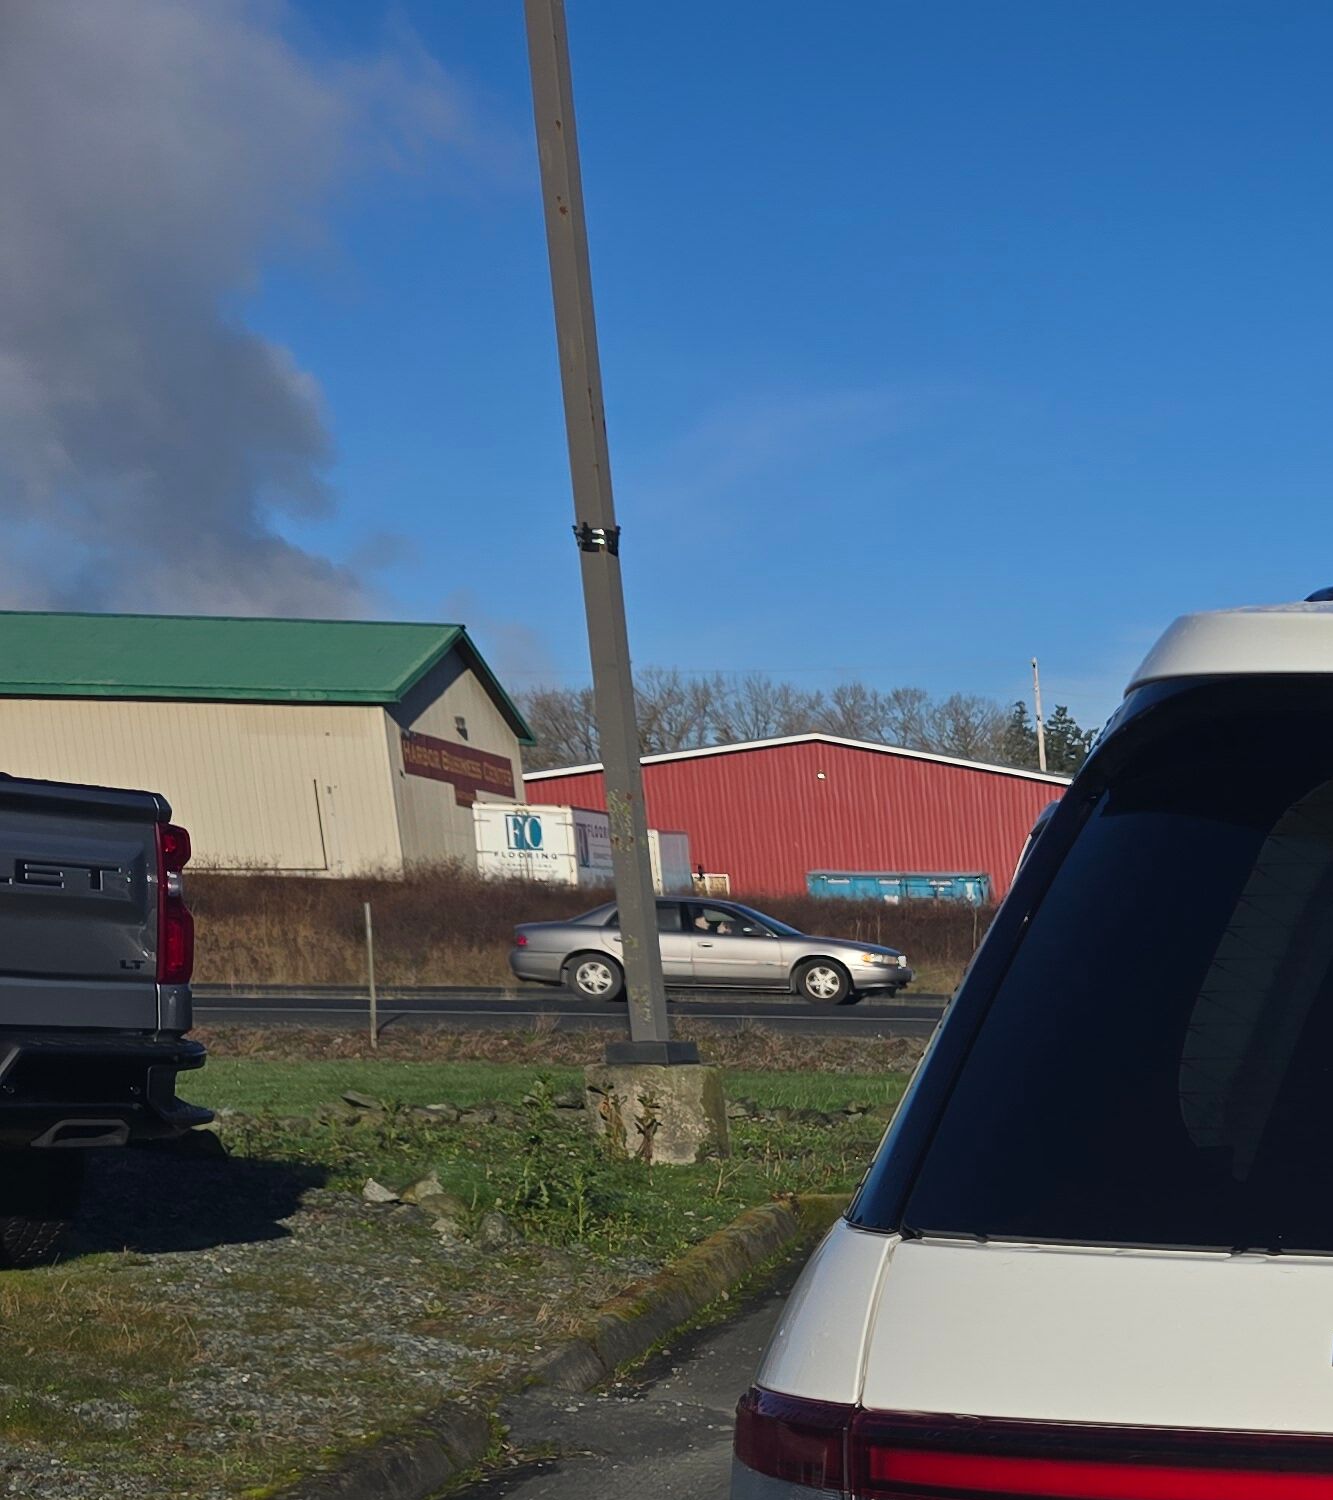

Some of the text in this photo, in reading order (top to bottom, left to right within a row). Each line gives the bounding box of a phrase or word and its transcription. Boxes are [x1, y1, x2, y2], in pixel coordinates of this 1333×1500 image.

[403, 741, 442, 769] HARBOR
[494, 851, 558, 860] FLOORING
[120, 960, 146, 970] LT
